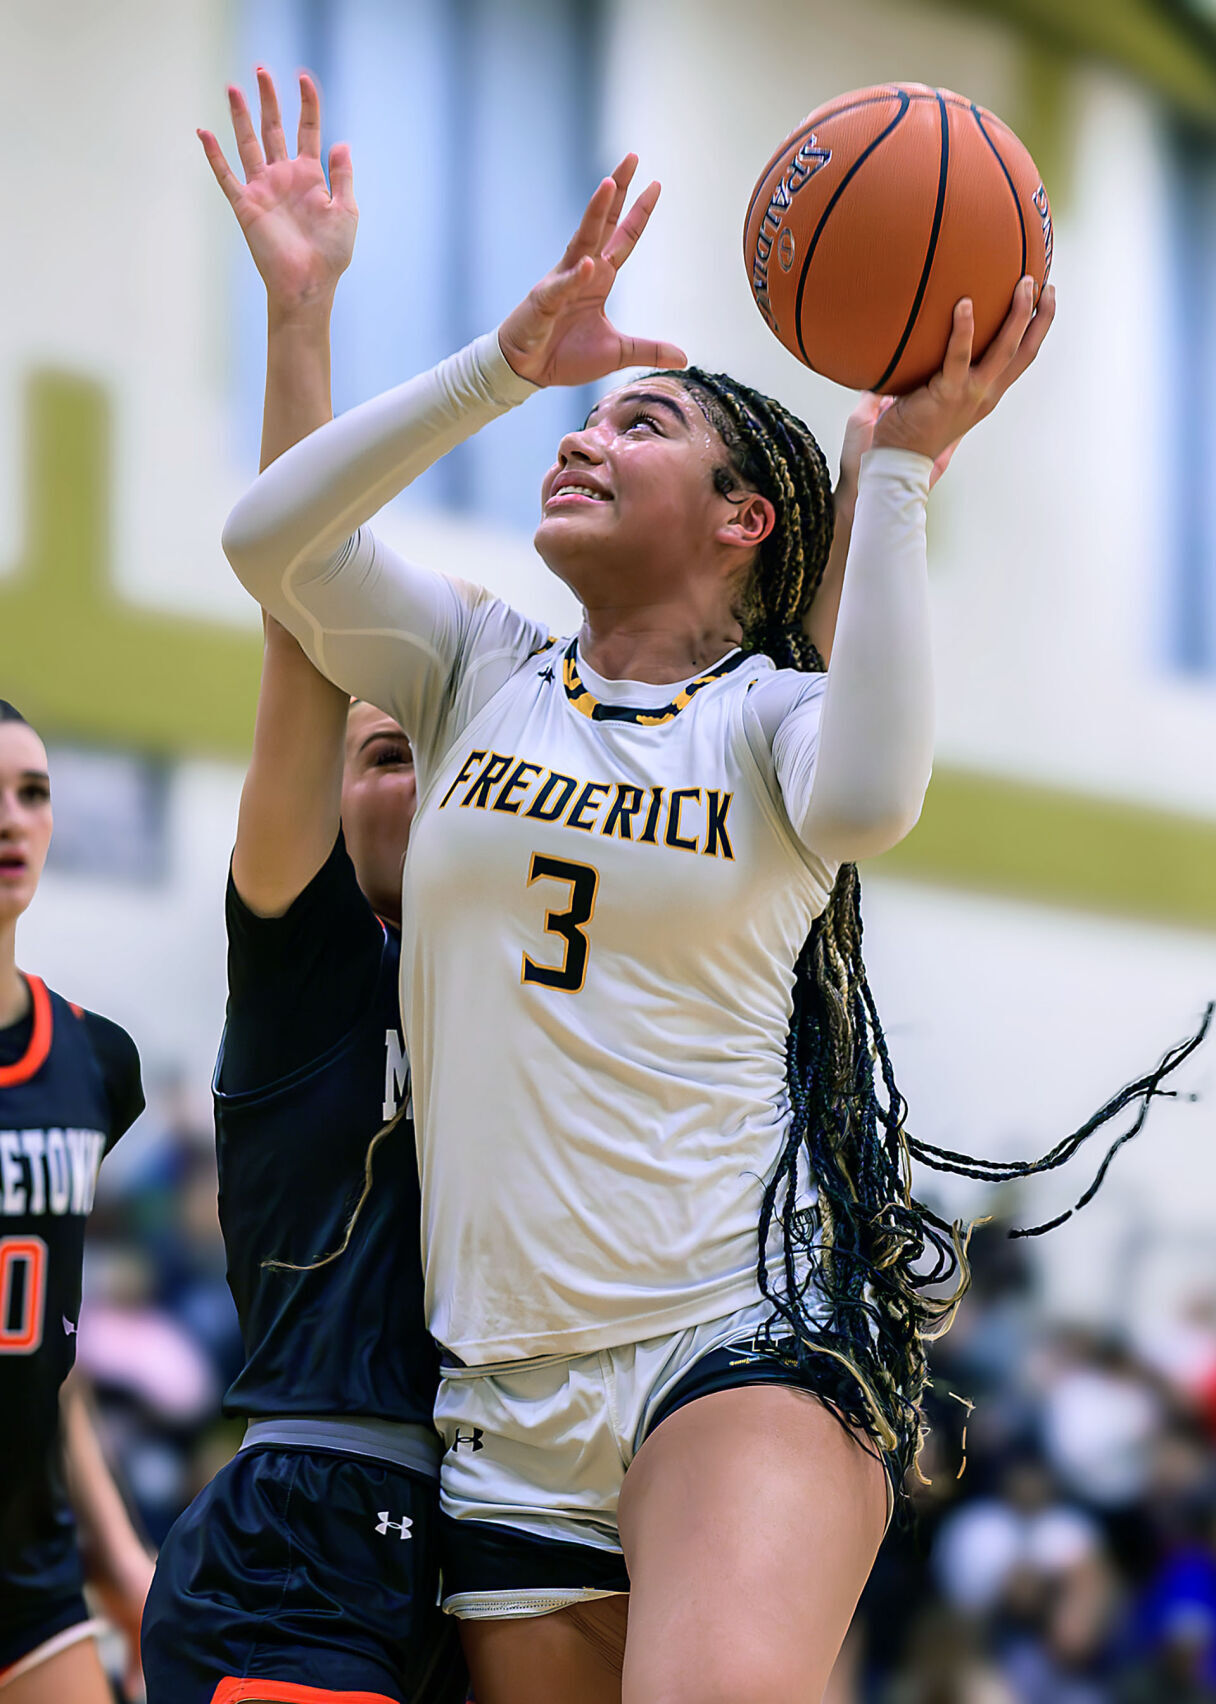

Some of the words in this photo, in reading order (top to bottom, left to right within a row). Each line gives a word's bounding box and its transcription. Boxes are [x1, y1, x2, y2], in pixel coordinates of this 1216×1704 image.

[438, 749, 736, 862] FREDERICK
[520, 851, 600, 995] 3
[0, 1127, 106, 1216] ETOW
